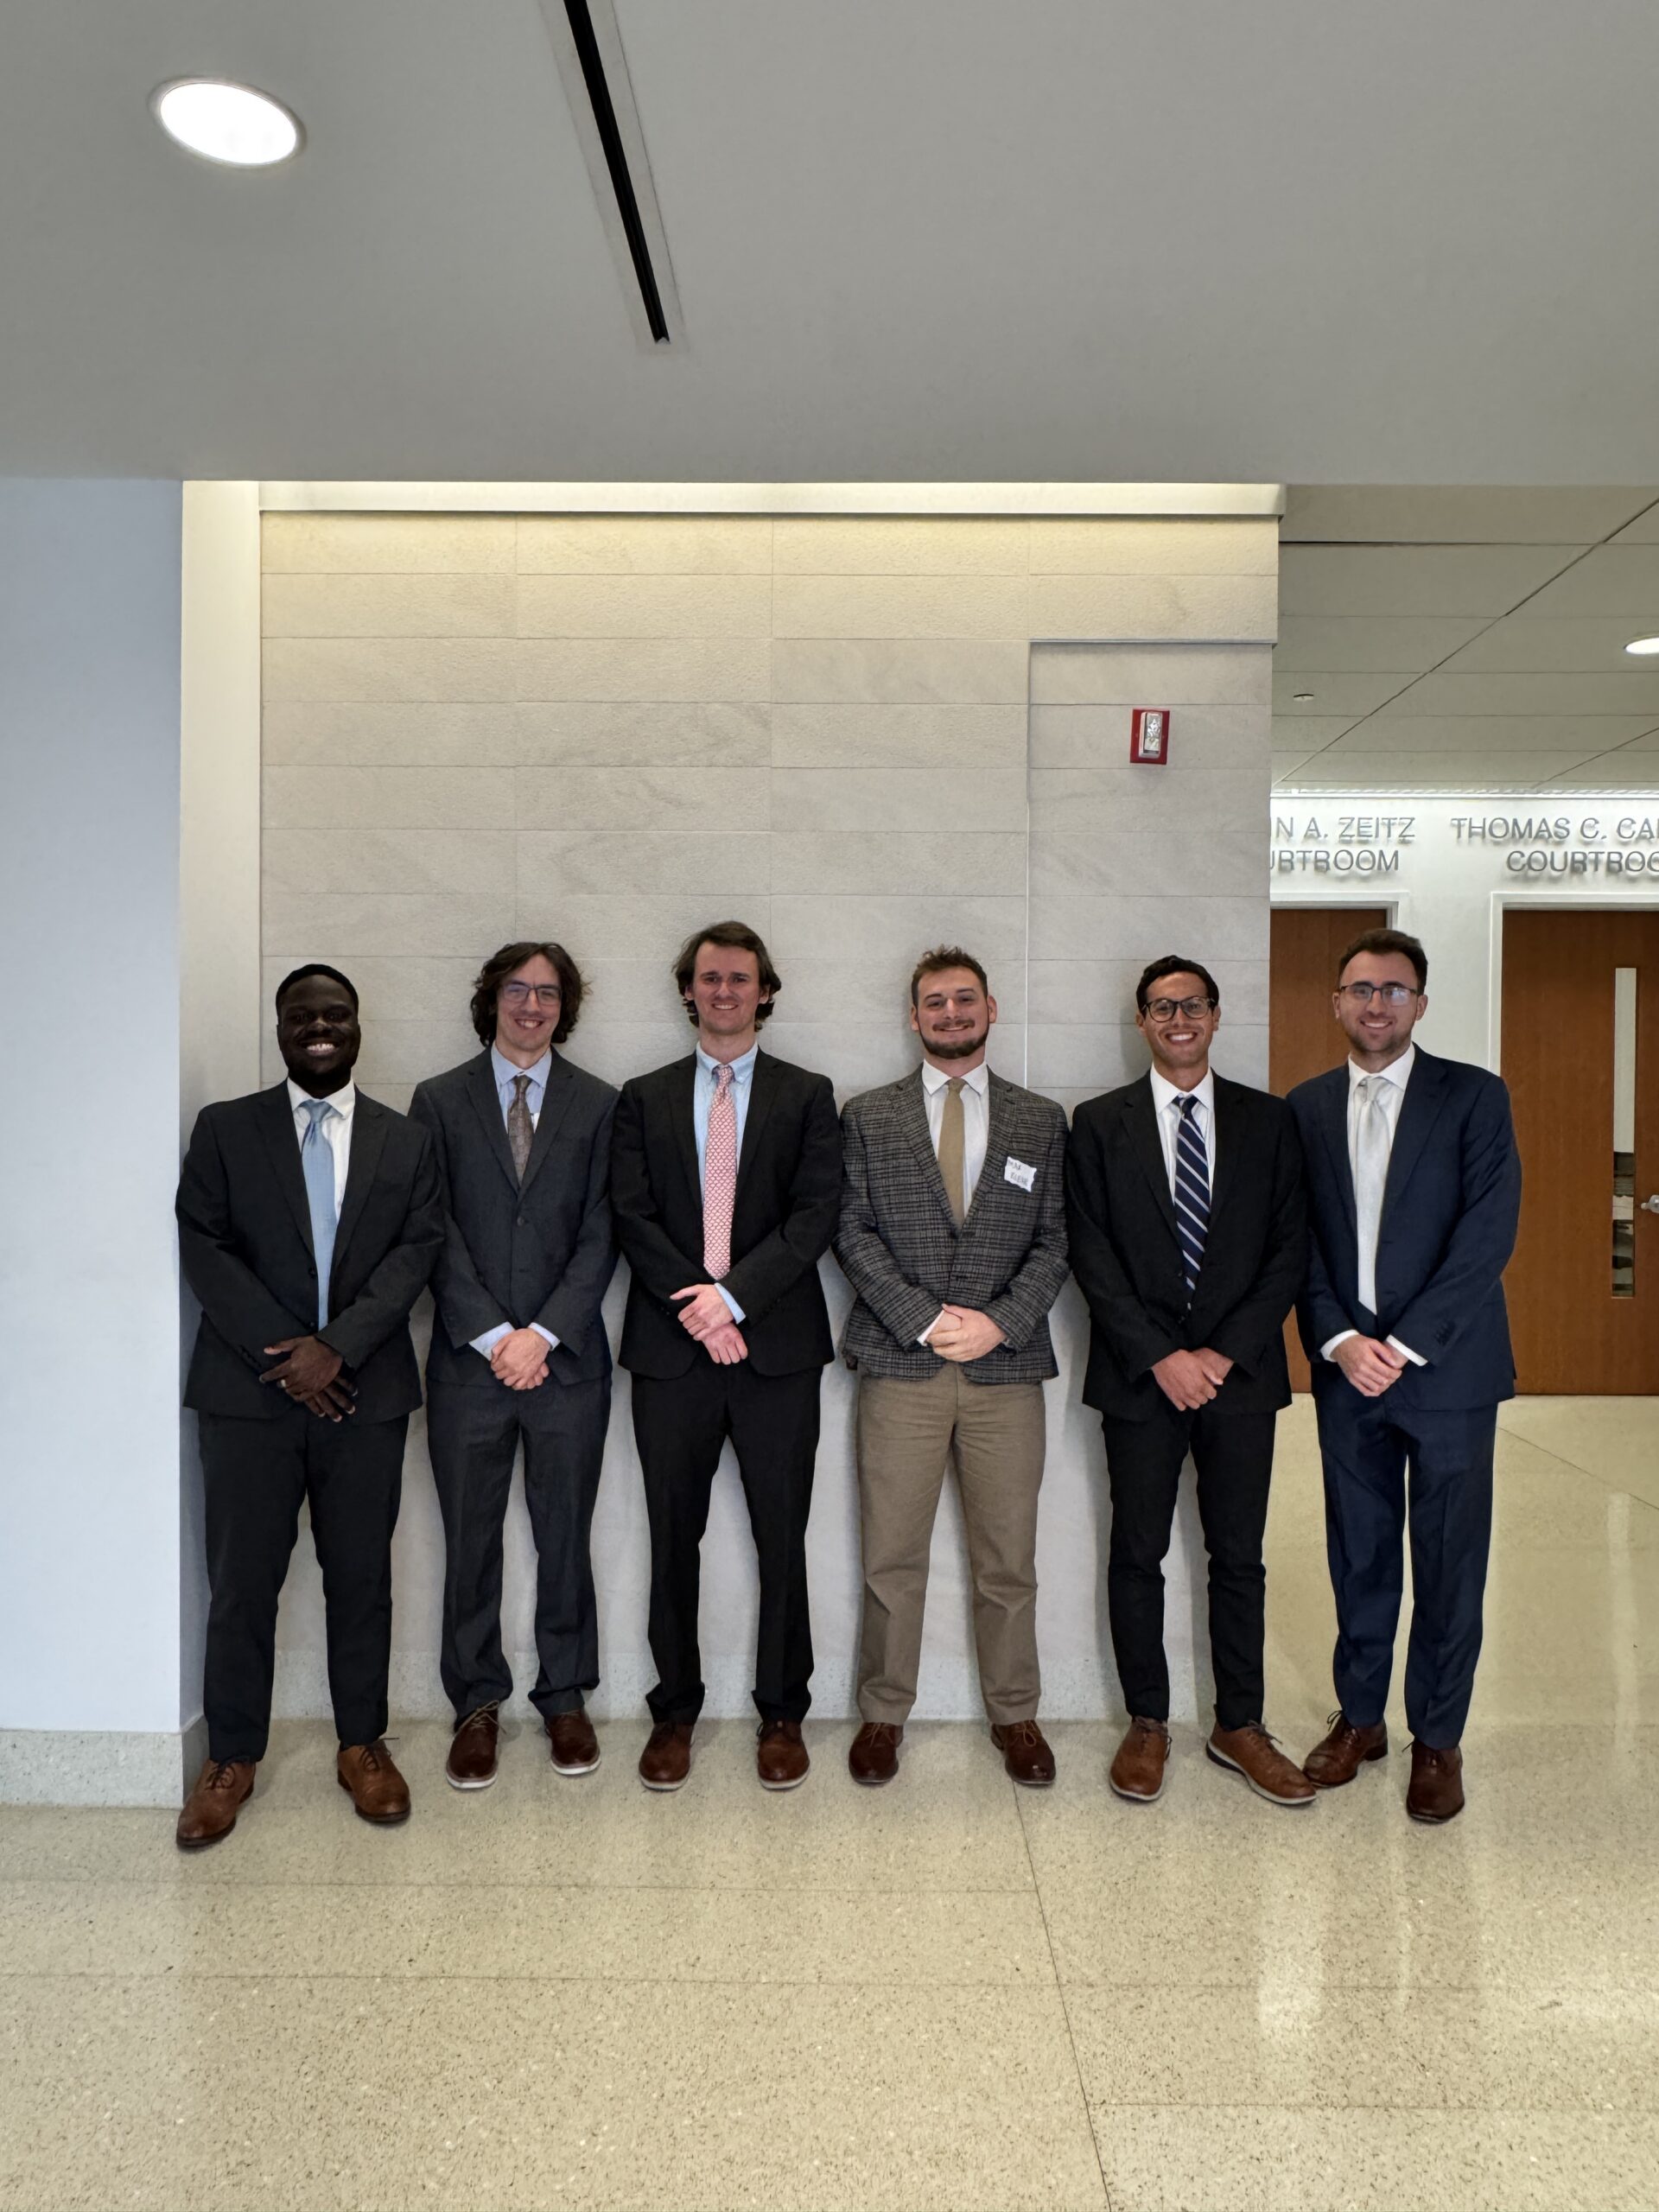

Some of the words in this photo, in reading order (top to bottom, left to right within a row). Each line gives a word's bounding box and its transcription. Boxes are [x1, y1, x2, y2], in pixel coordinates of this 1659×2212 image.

[1270, 817, 1294, 838] N
[1304, 817, 1329, 839] A.
[1338, 817, 1416, 839] ZEITZ
[1451, 817, 1571, 840] THOMAS
[1580, 817, 1607, 840] C.
[1617, 817, 1659, 840] CA
